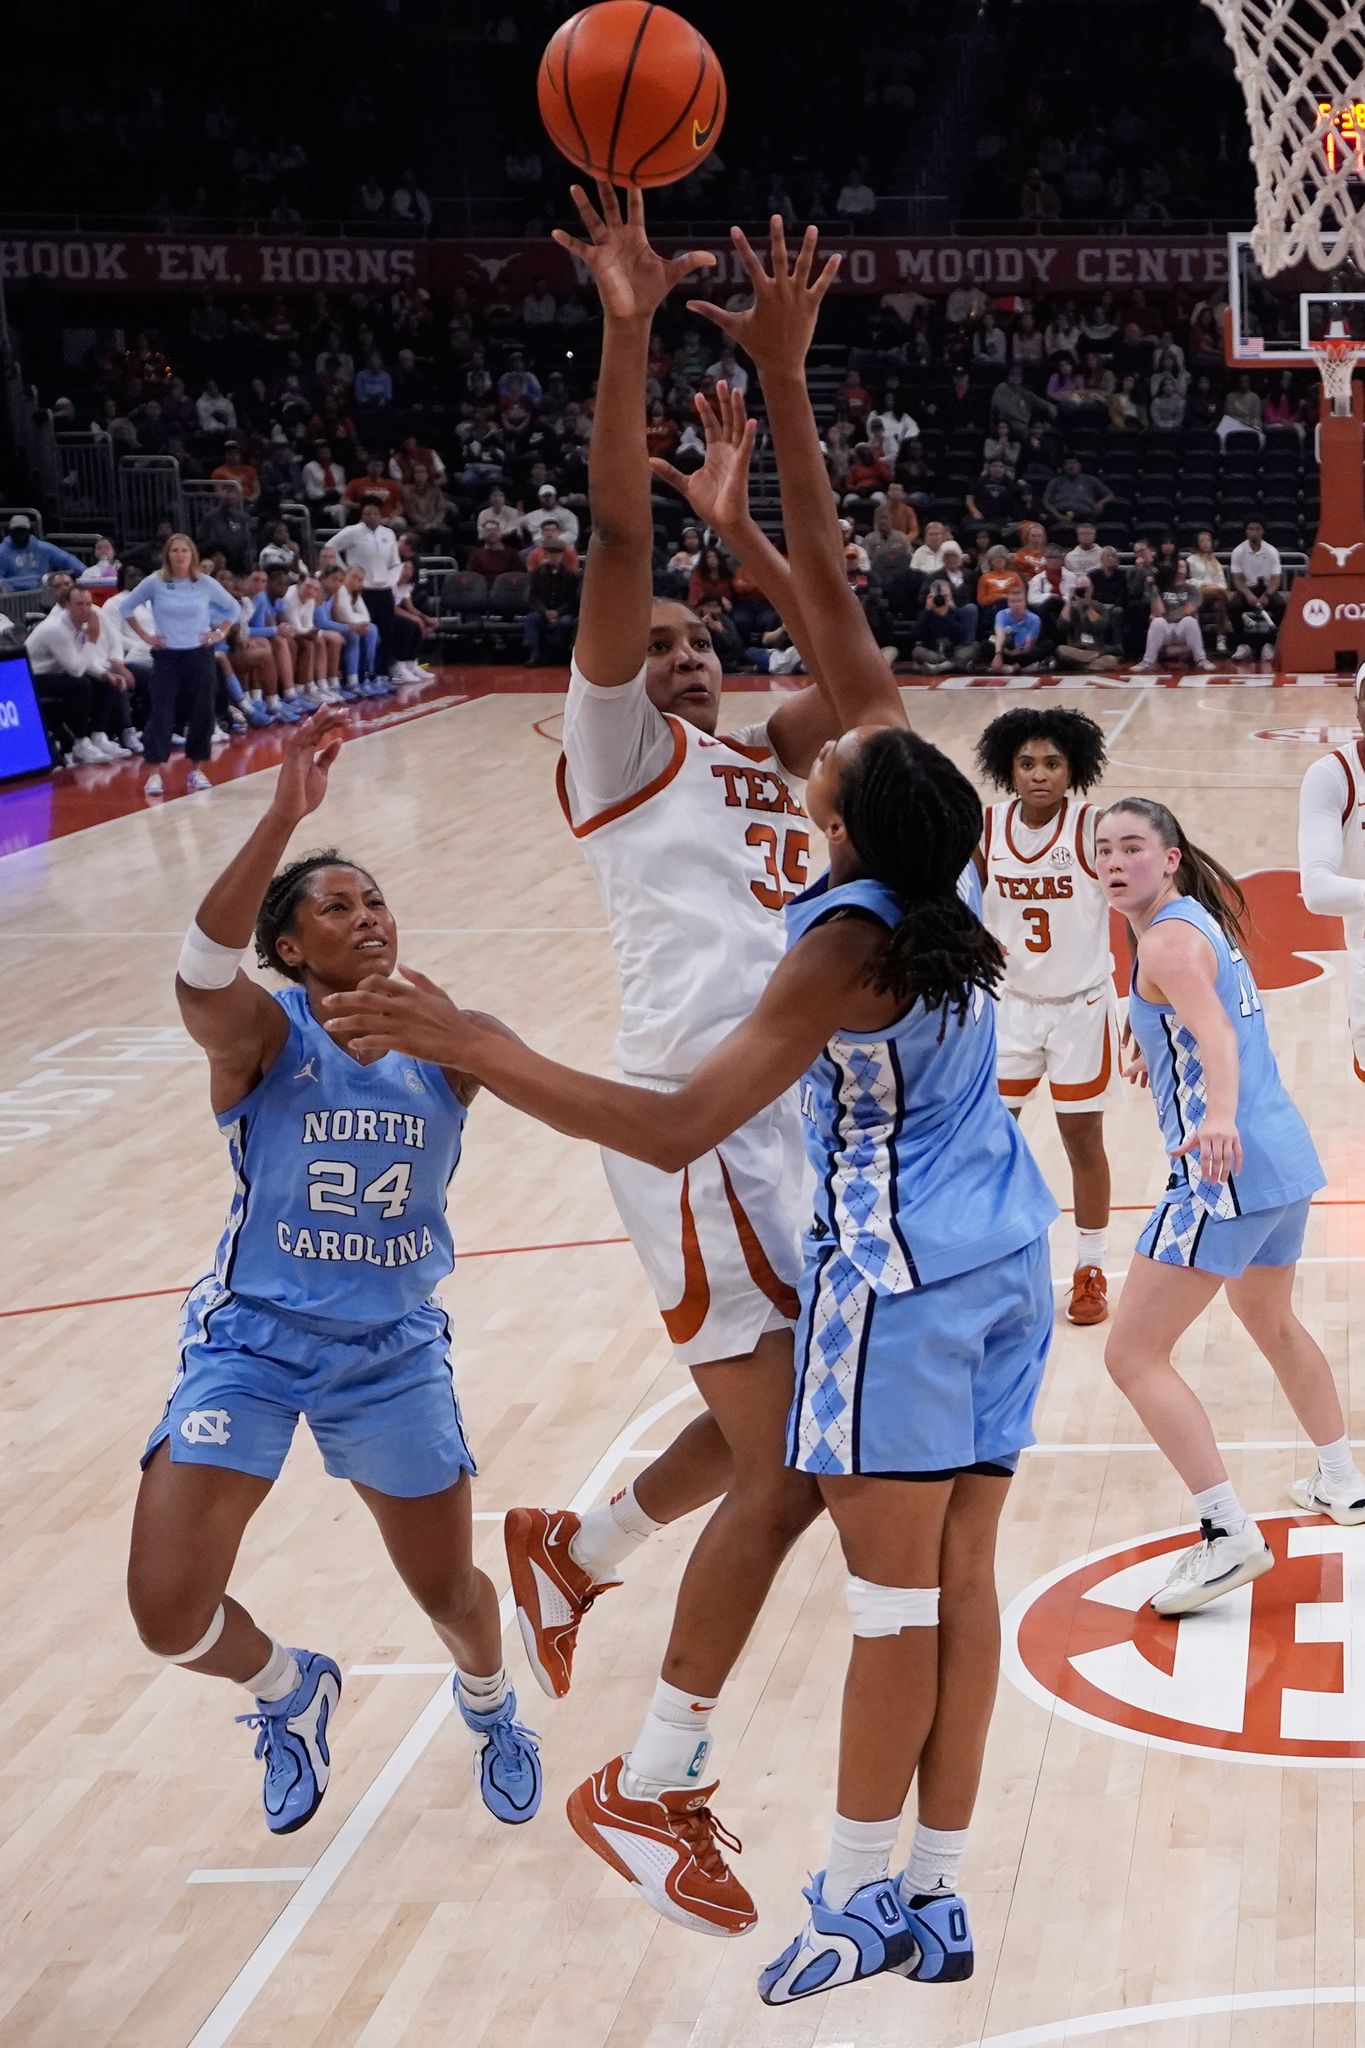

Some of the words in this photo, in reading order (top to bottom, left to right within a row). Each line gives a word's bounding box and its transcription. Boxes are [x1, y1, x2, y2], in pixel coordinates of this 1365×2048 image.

[0, 241, 129, 280] HOOK
[259, 246, 415, 284] HORNS
[896, 248, 1057, 283] MOODY
[745, 822, 810, 911] 35
[994, 874, 1074, 900] TEXAS
[1022, 908, 1052, 953] 3
[302, 1108, 425, 1149] NORTH
[308, 1159, 412, 1219] 24
[276, 1219, 434, 1267] CAROLINA
